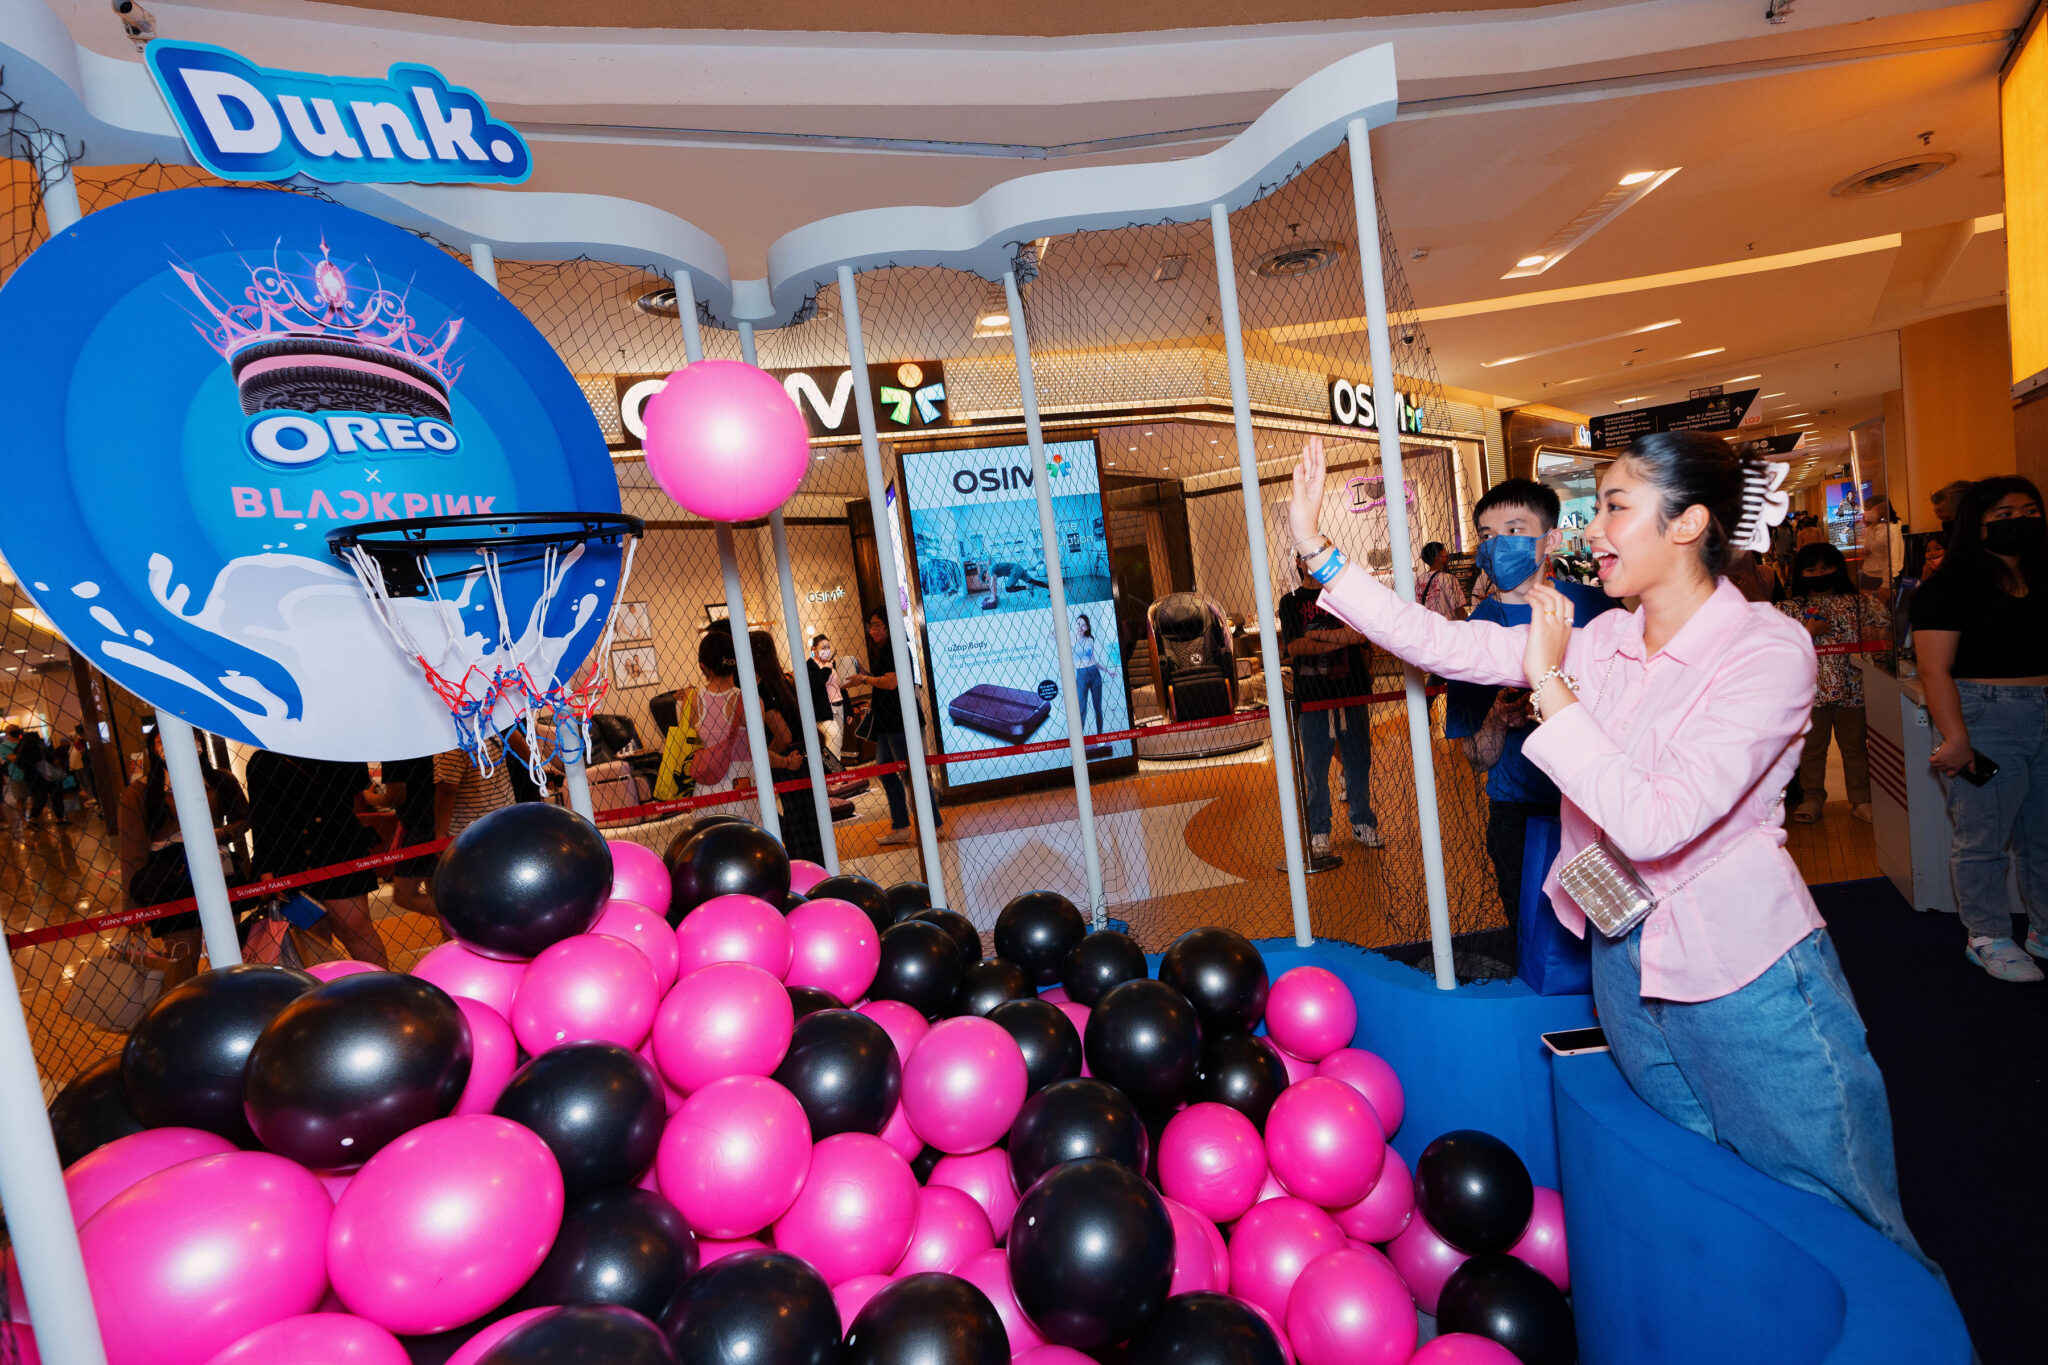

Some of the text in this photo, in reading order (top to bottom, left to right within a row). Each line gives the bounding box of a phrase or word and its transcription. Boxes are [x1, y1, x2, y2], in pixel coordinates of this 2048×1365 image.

[178, 67, 514, 163] Dunk.
[251, 416, 458, 464] OREO
[230, 486, 497, 520] BLACKPINK
[807, 590, 837, 603] OSIM
